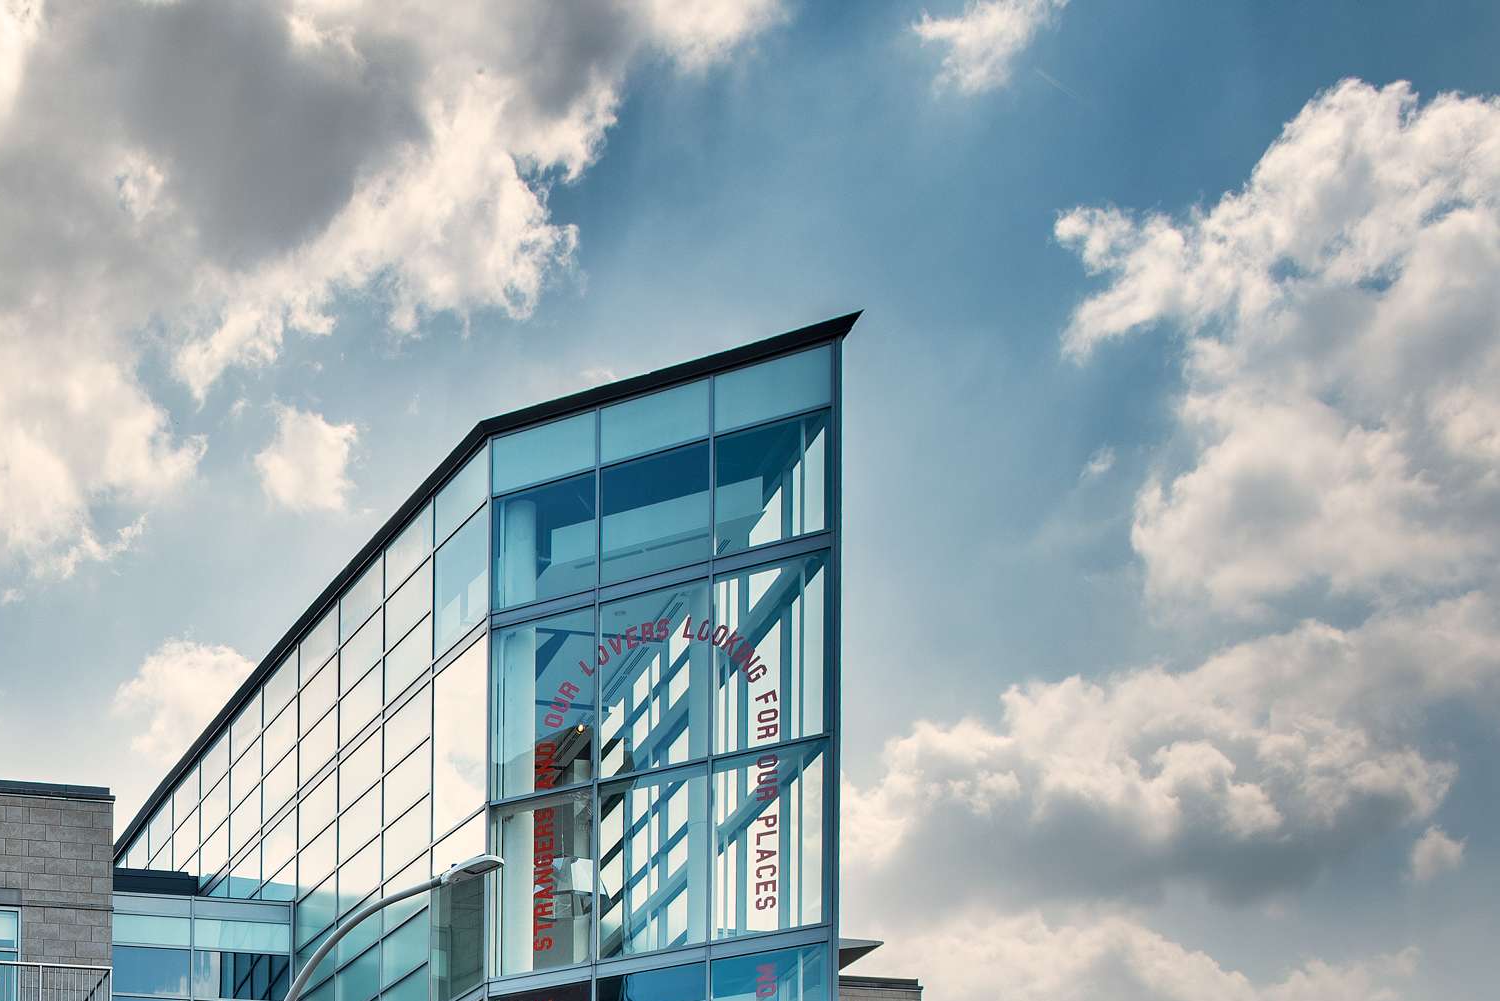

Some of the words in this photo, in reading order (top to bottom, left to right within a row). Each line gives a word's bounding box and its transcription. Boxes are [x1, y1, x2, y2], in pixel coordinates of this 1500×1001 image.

[579, 618, 670, 677] LOVERS
[682, 617, 768, 683] LOOKING
[544, 680, 580, 728] OUR
[755, 689, 779, 740] FOR
[534, 741, 557, 789] AND
[756, 754, 780, 801] OUR
[533, 808, 556, 951] STRANGERS
[755, 814, 778, 911] PLACES
